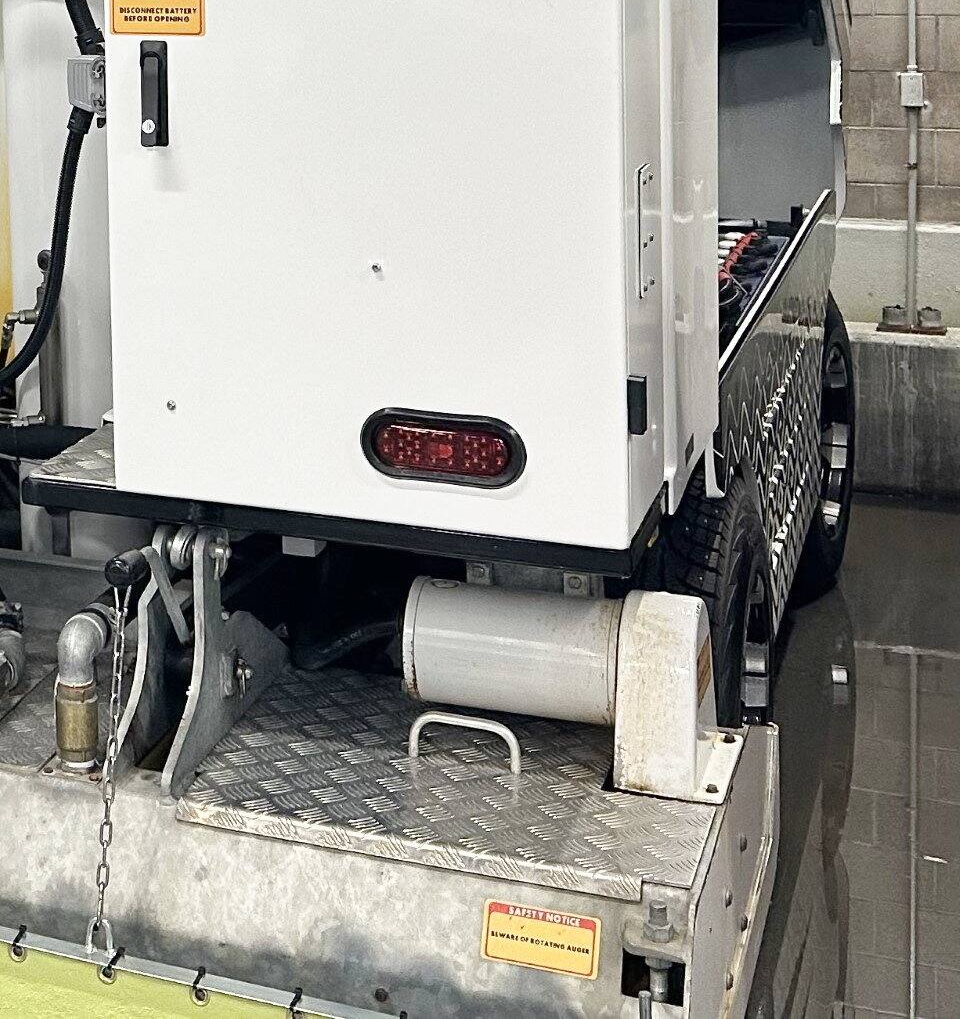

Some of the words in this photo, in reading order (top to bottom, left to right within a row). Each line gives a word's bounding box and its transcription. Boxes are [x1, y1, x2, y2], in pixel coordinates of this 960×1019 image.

[508, 906, 544, 920] SAFETY
[545, 912, 581, 927] NOTICE
[491, 930, 519, 941] BEWARE
[530, 938, 565, 950] ROTATING
[567, 945, 590, 955] AUGER
